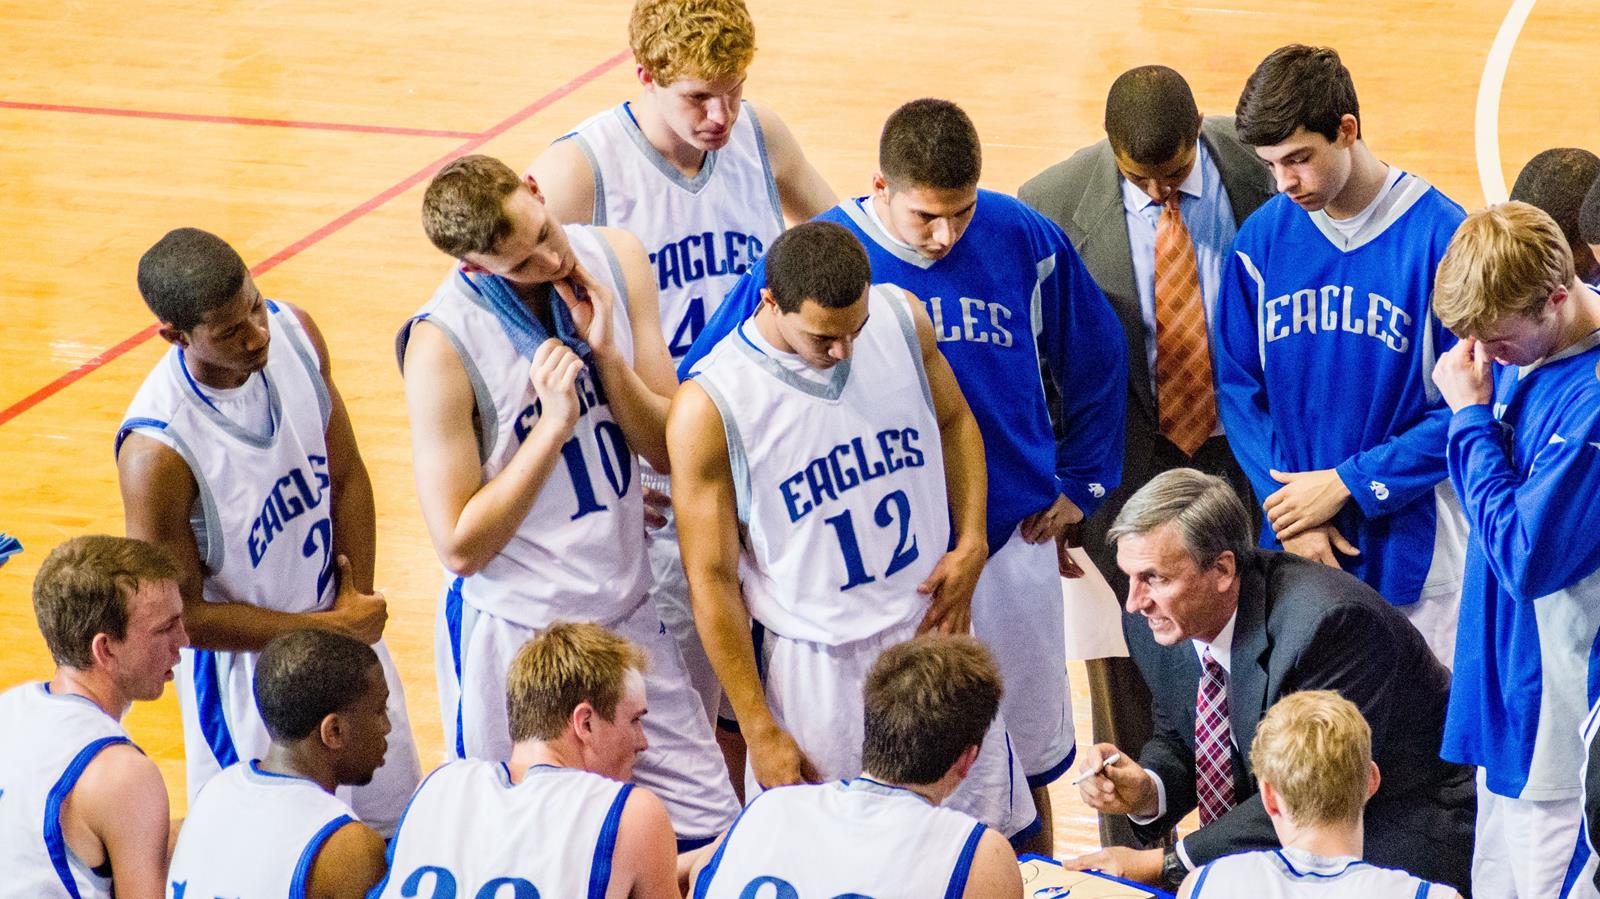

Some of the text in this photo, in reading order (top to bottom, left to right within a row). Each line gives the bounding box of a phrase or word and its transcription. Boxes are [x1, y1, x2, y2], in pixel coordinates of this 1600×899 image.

[920, 297, 1013, 348] LES
[1265, 285, 1413, 354] EAGLES
[561, 421, 631, 521] 10
[779, 427, 925, 523] EAGLES
[824, 489, 920, 592] 12
